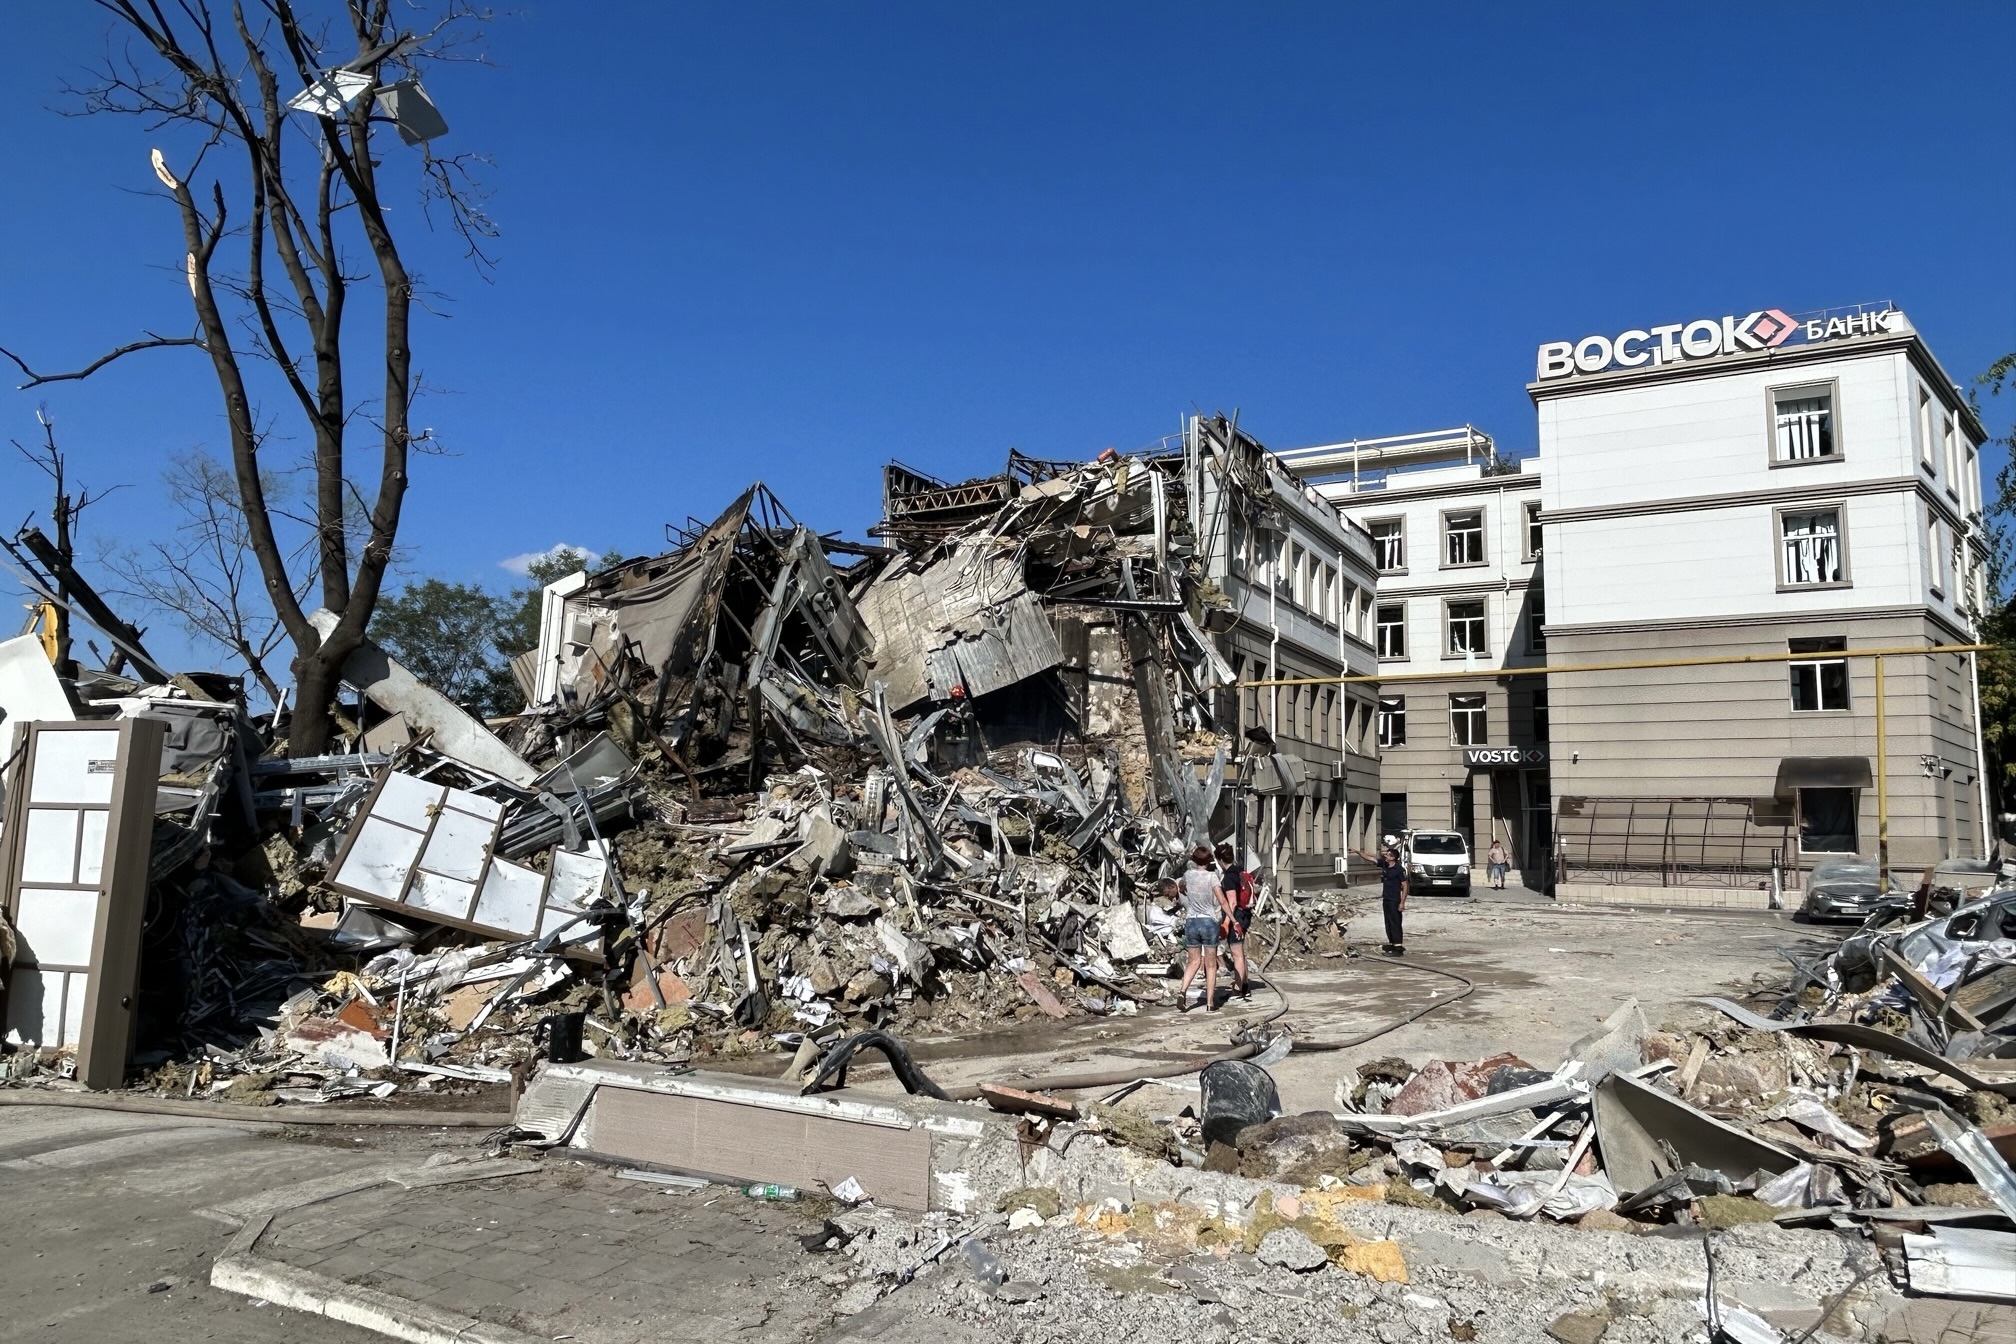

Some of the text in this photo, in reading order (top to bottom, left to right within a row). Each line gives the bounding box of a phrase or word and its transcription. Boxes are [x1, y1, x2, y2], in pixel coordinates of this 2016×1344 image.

[1538, 309, 1890, 379] ВОСТОК БАНК
[1468, 750, 1534, 763] VOSTOK
